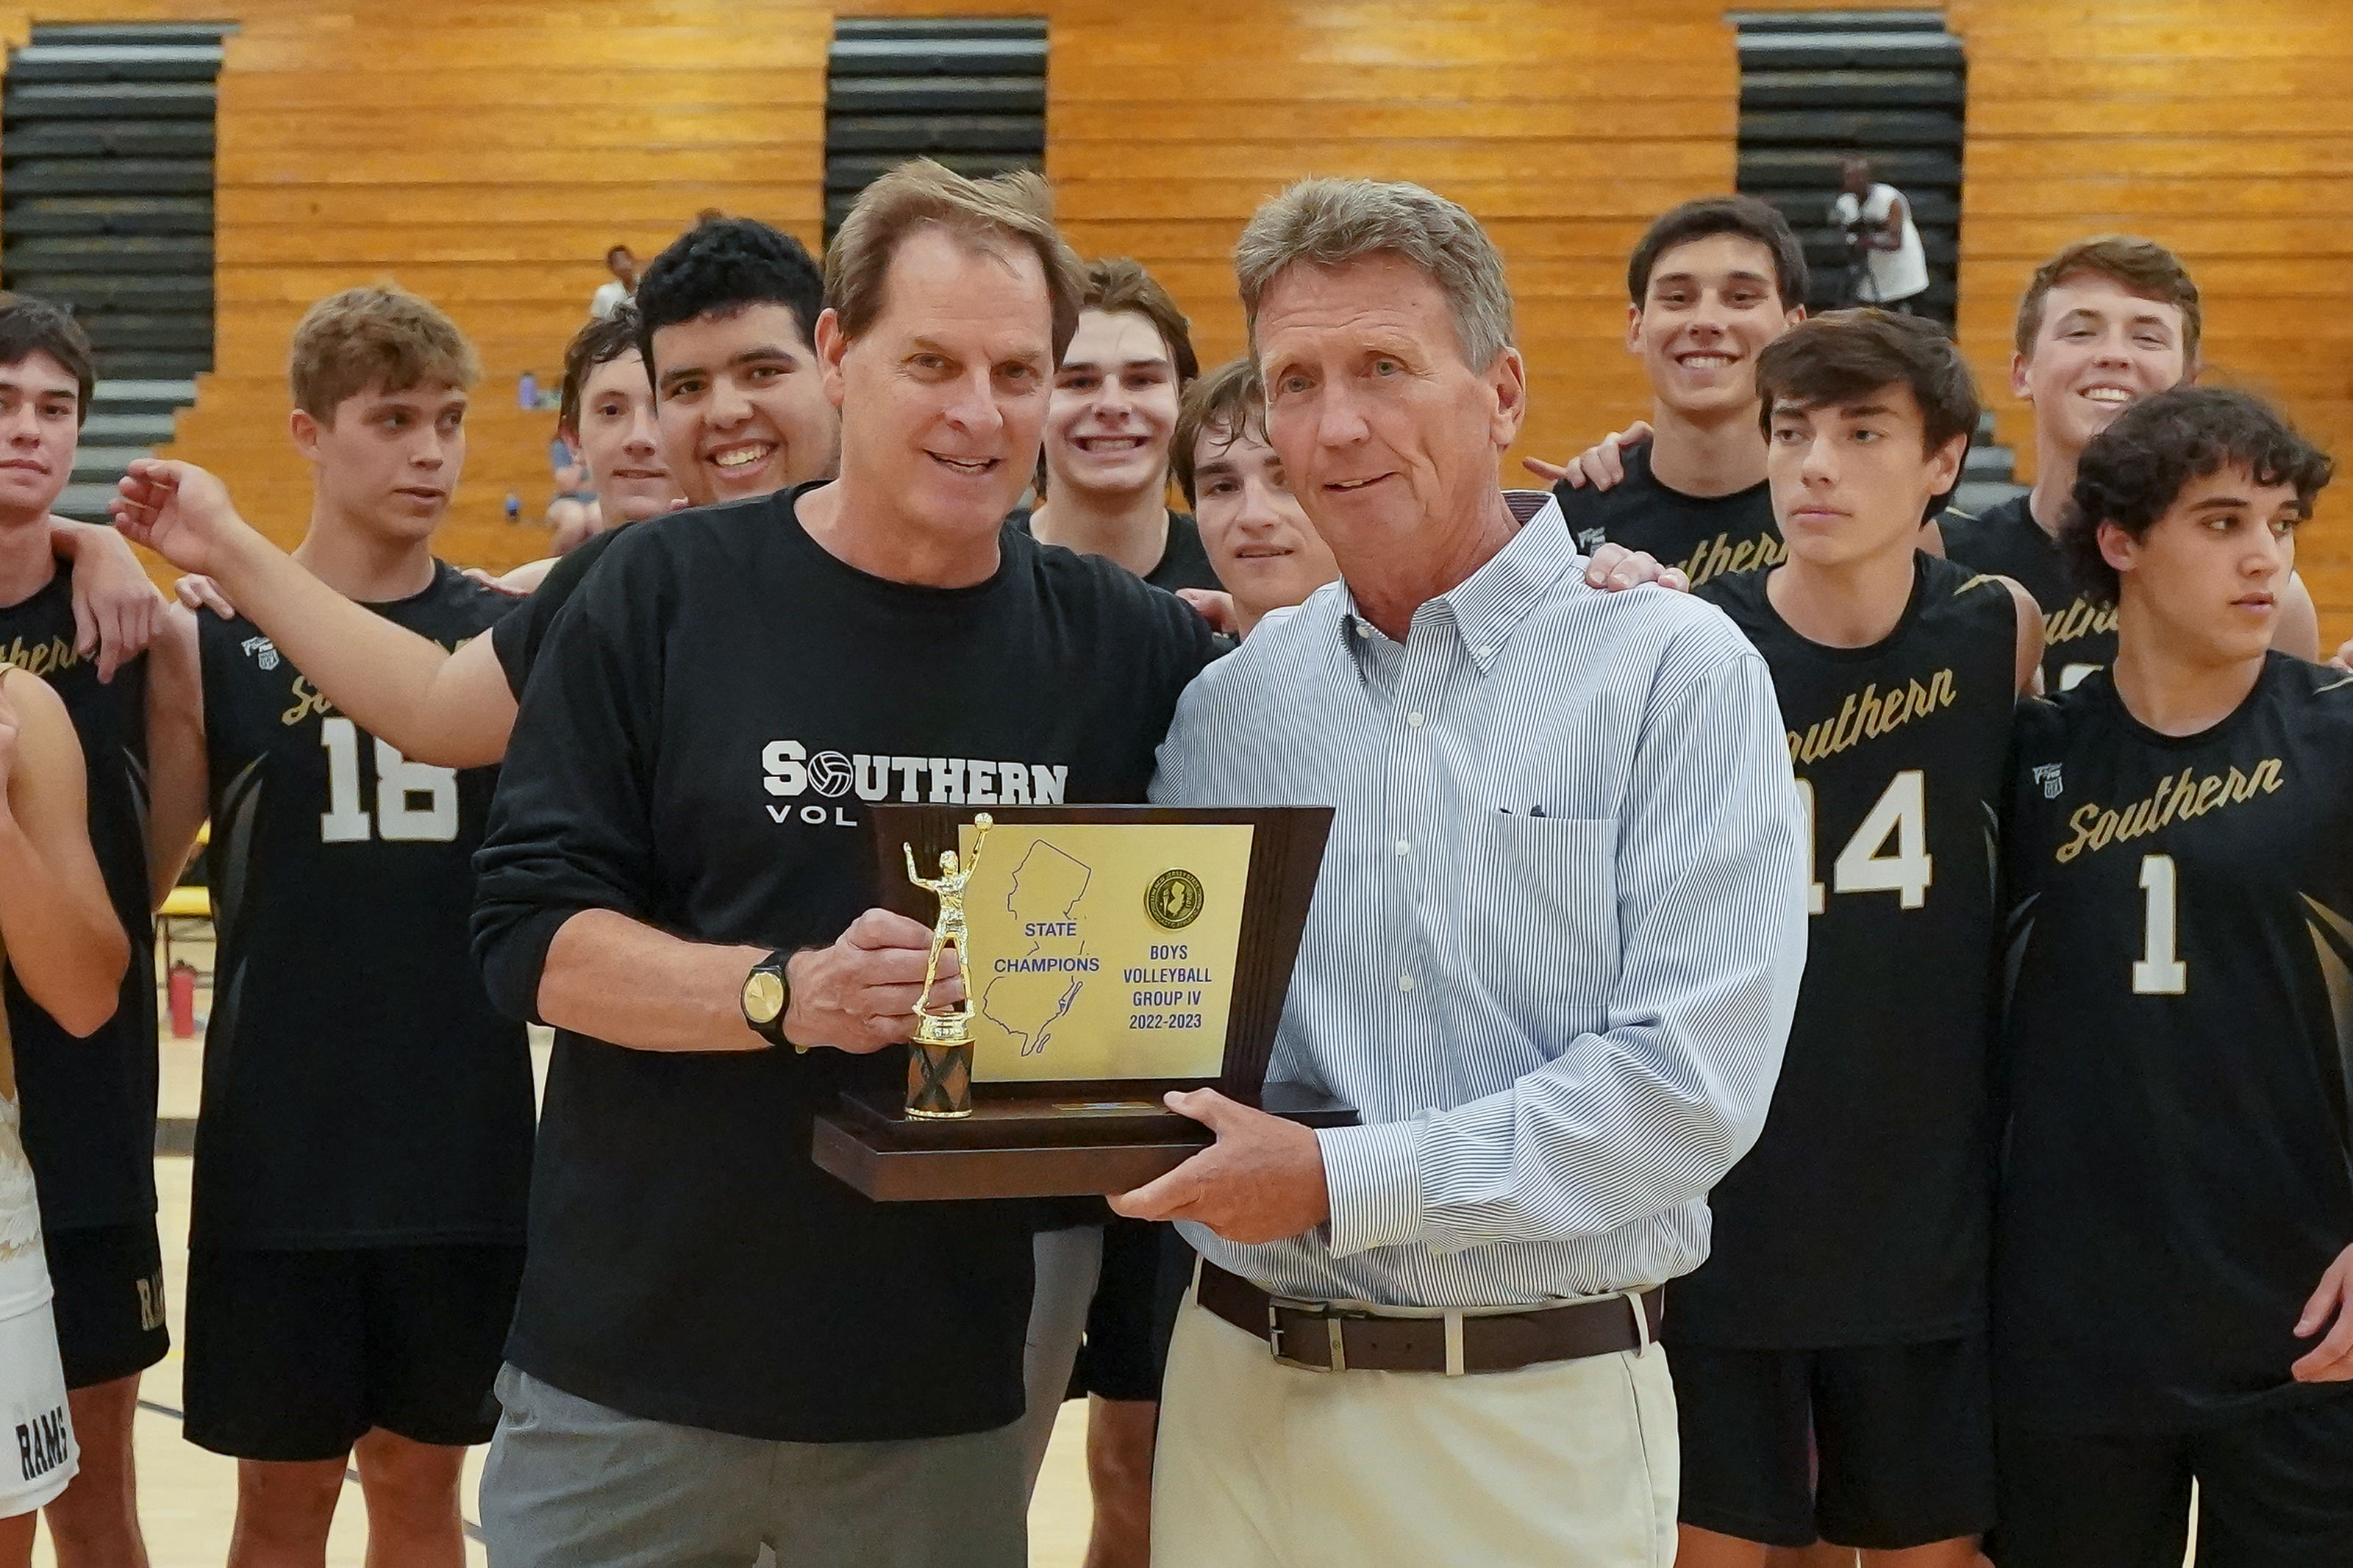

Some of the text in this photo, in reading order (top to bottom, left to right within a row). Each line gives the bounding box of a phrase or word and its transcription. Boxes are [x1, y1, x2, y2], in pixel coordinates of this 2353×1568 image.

[1787, 667, 1957, 765] outhern
[320, 717, 460, 843] 18
[2055, 758, 2285, 864] Southern
[1024, 922, 1077, 937] STATE
[2132, 853, 2187, 995] 1
[1150, 945, 1188, 961] BOYS
[993, 957, 1100, 973] CHAMPIONS
[1123, 968, 1213, 984] VOLLEYBALL
[1132, 990, 1202, 1006] GROUP IV
[1129, 1013, 1202, 1030] 2022-2023
[15, 1405, 68, 1481] RAMS
